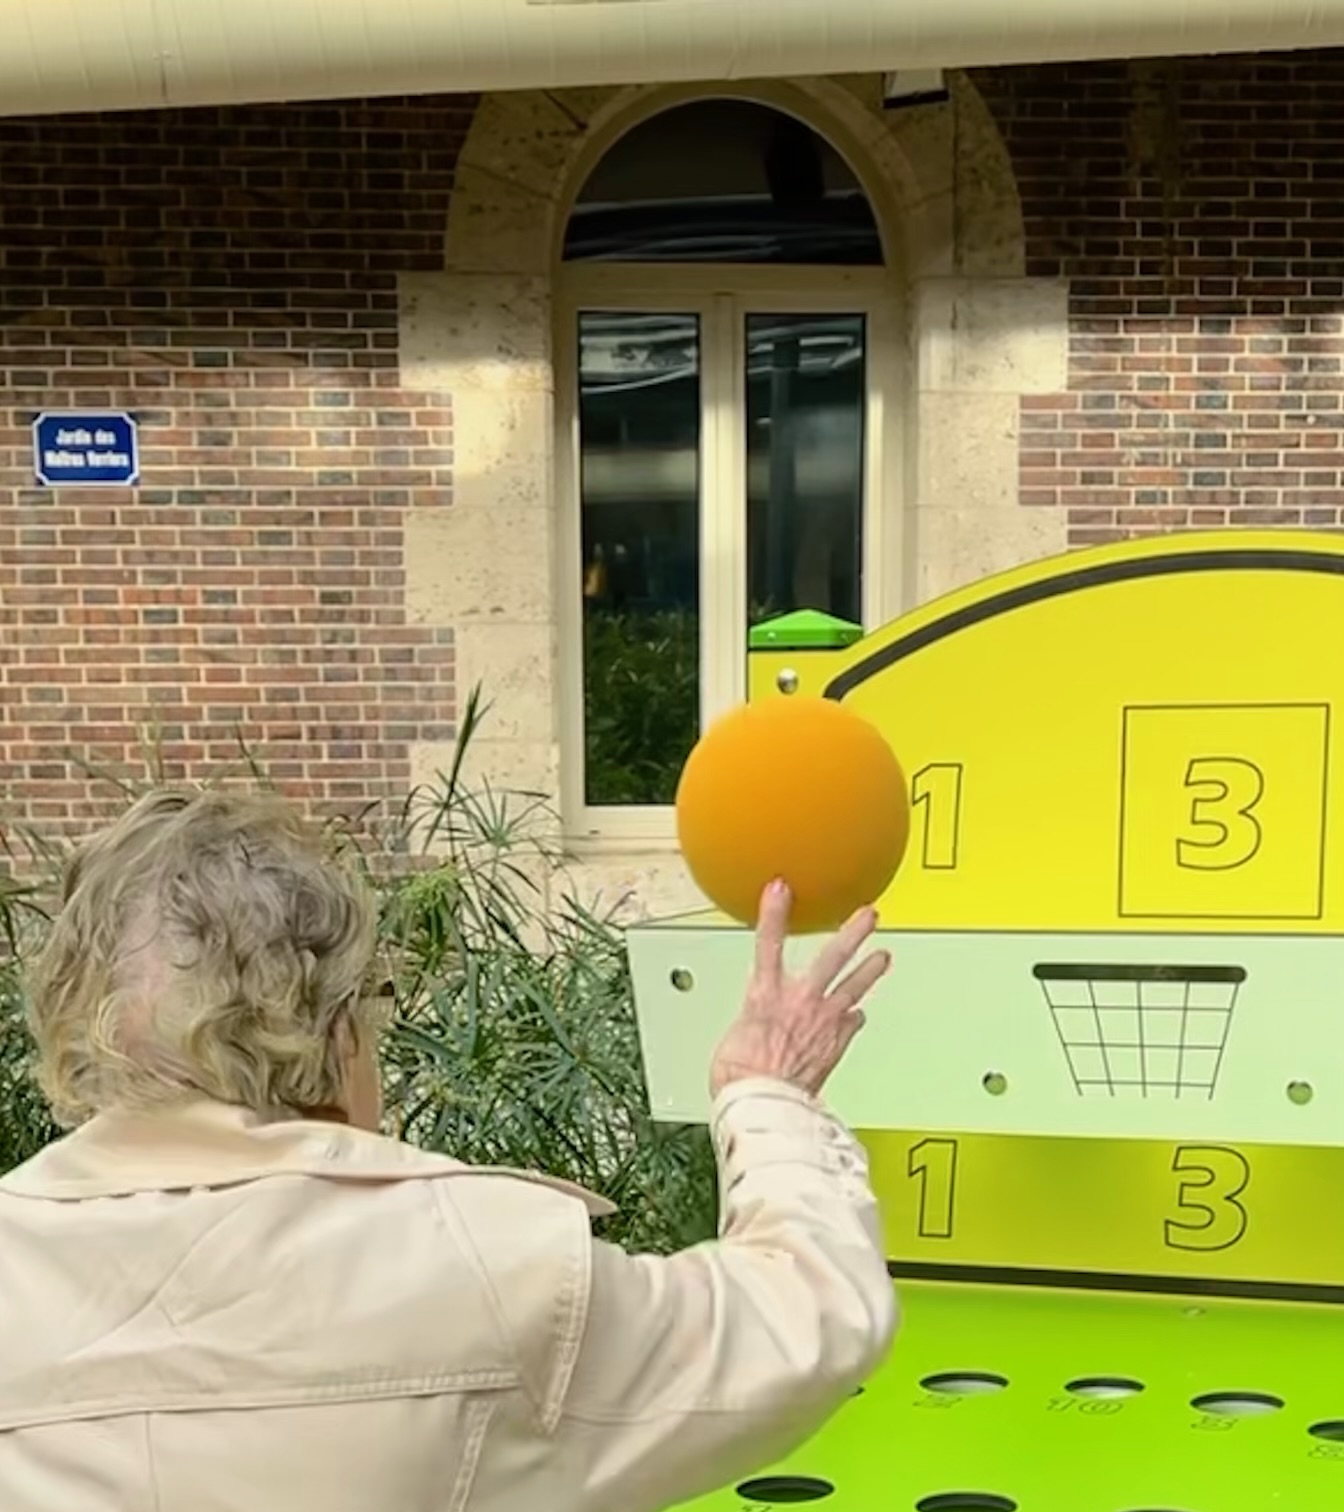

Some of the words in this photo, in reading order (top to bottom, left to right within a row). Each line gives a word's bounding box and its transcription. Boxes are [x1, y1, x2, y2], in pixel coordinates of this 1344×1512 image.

[911, 763, 962, 869] 1
[1175, 757, 1265, 870] 3
[907, 1138, 957, 1238] 1
[1164, 1145, 1250, 1251] 3
[1045, 1397, 1123, 1415] 10
